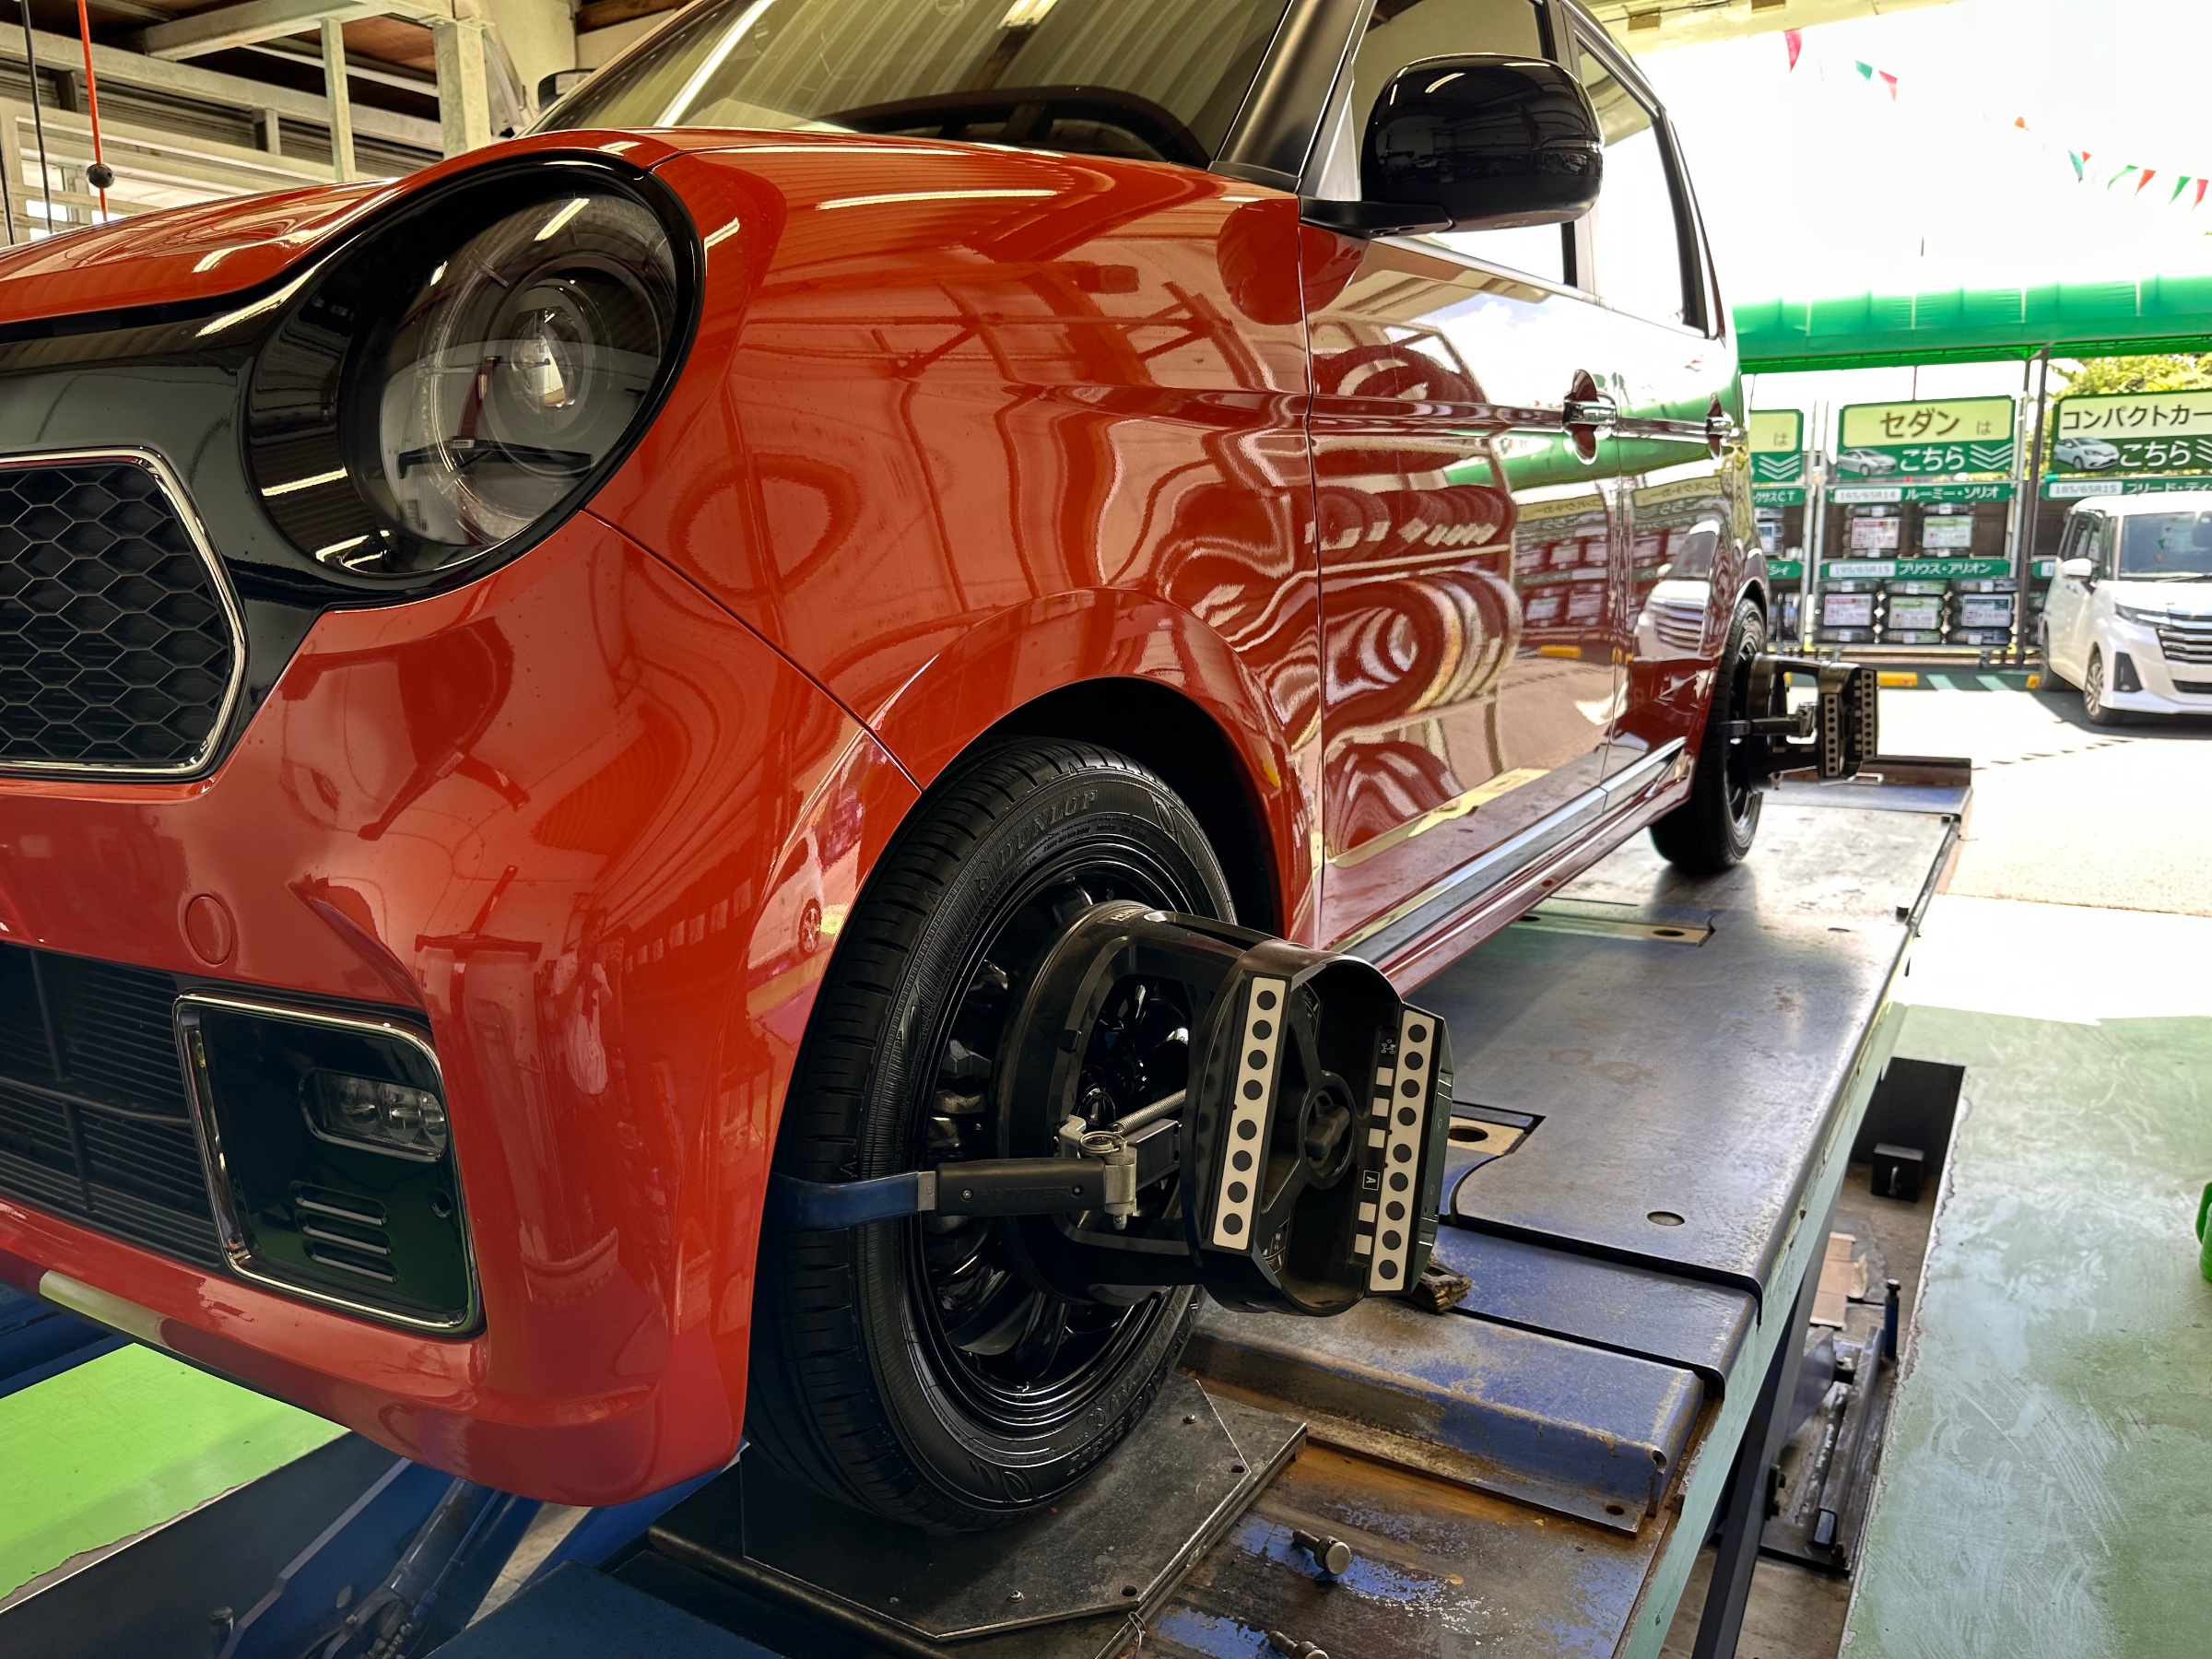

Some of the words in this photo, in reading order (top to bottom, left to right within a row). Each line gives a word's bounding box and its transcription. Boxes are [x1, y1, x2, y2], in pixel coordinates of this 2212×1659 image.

[1879, 406, 1960, 439] セダン
[1976, 420, 1992, 436] は
[2062, 404, 2212, 431] コンパクトカー
[1773, 431, 1789, 446] は
[1900, 445, 1965, 472] こちら
[2120, 441, 2192, 467] こちら
[1904, 488, 2000, 500] ルーミー・ソリオ
[2055, 486, 2117, 495] 185/65R15
[1899, 562, 1992, 575] プリウス・アリオン
[1000, 790, 1098, 871] DUNLOP
